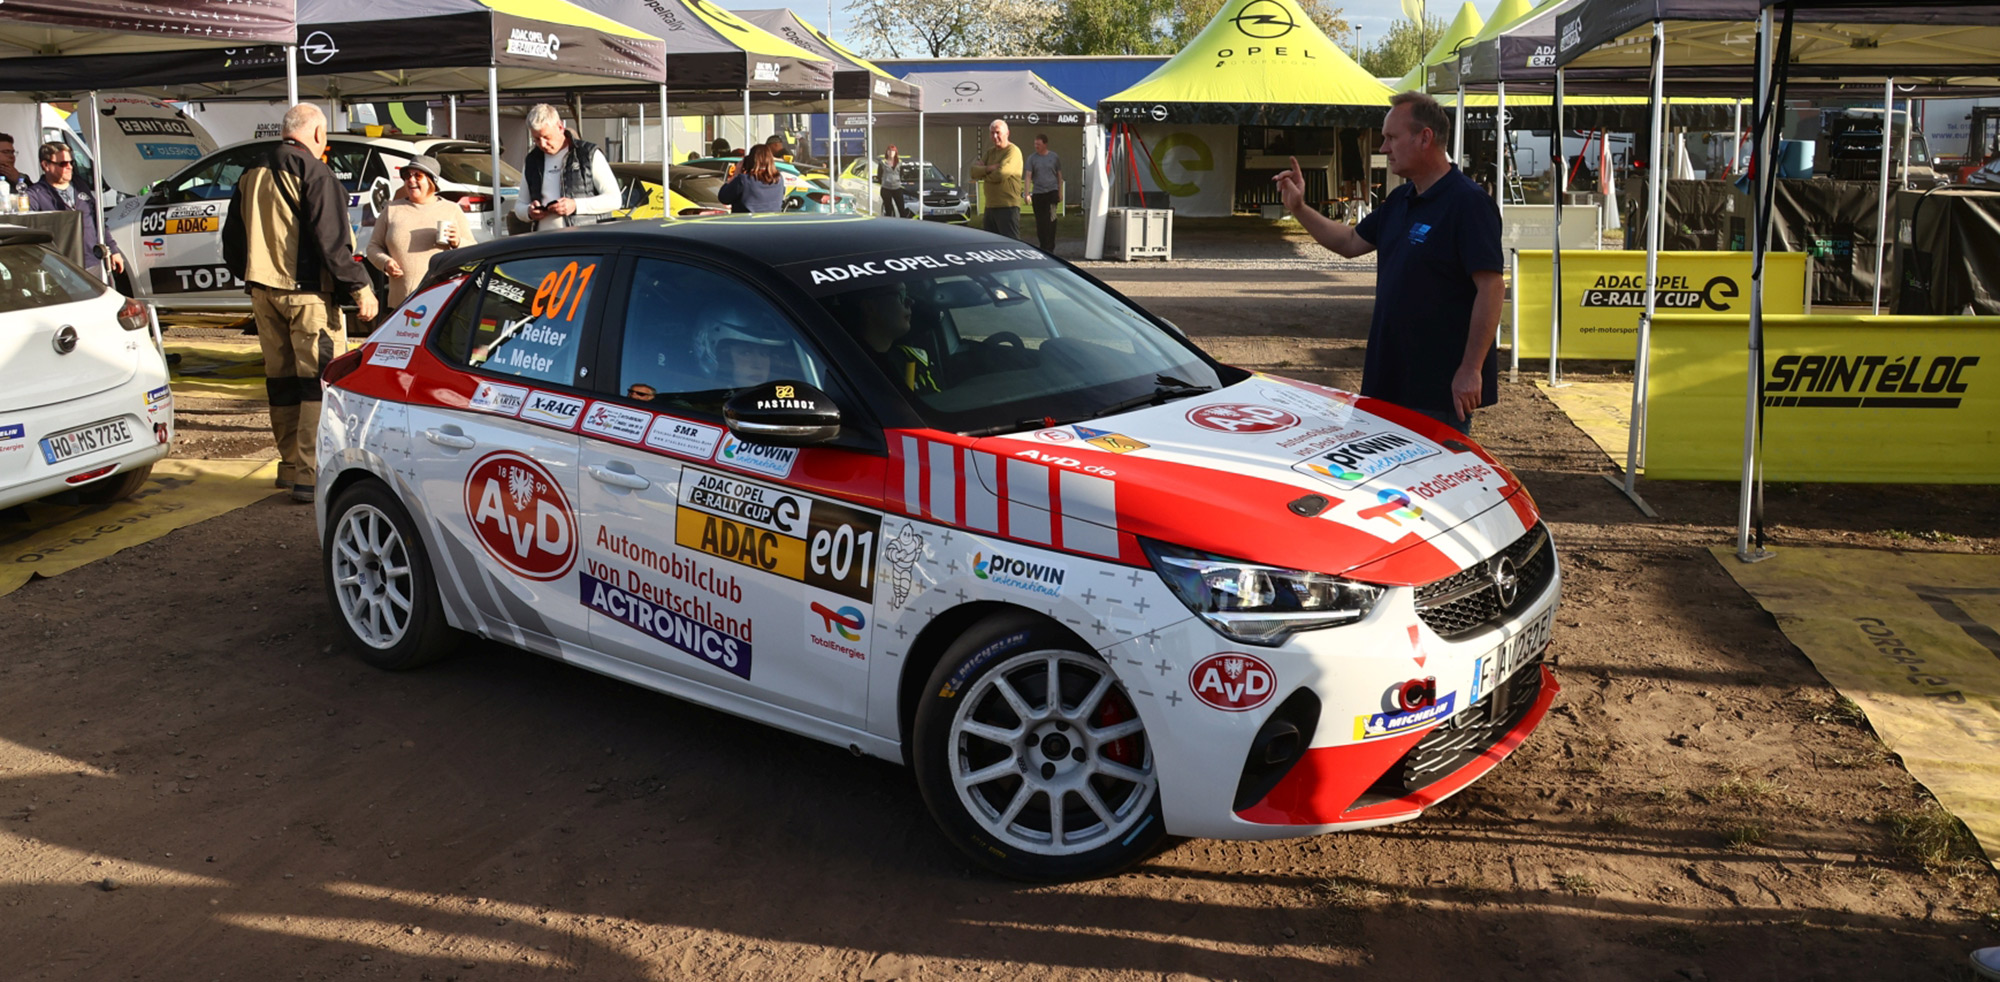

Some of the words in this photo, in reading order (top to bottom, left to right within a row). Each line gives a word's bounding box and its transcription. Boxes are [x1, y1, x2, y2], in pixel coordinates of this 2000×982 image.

[1217, 46, 1316, 59] OPEL
[1535, 46, 1556, 55] ADA
[119, 121, 191, 133] TOPLINER
[1057, 114, 1078, 123] ADAC
[142, 211, 166, 232] e05
[177, 217, 208, 233] ADAC
[1815, 239, 1850, 249] charge
[175, 267, 246, 290] TOPL
[809, 262, 887, 285] ADAC
[884, 255, 948, 272] OPEL
[943, 249, 1016, 266] e-RALLY
[1013, 249, 1048, 261] CUP
[531, 261, 597, 322] e01
[1594, 275, 1643, 289] ADAC
[1664, 292, 1700, 306] CUP
[501, 319, 517, 339] M.
[520, 323, 567, 347] Reiter
[494, 345, 506, 365] L.
[510, 348, 554, 373] Meter
[530, 397, 581, 418] X-RACE
[757, 399, 815, 411] PASTABOX
[1207, 404, 1286, 433] AvD
[51, 438, 72, 459] HO
[77, 431, 96, 452] MS
[95, 422, 131, 447] 773E
[673, 424, 699, 438] SMR
[0, 443, 25, 452] Energies
[735, 454, 788, 473] international
[1015, 449, 1117, 477] AvD.de
[498, 465, 507, 479] 18
[535, 481, 548, 495] 99
[698, 475, 733, 494] ADAC
[733, 484, 765, 503] OPEL
[1405, 463, 1492, 501] TotalEnergies
[475, 477, 570, 559] AvD
[692, 489, 744, 516] e-RALLY
[743, 503, 771, 522] CUP
[596, 524, 743, 604] Automobilclub
[701, 516, 779, 570] ADAC
[811, 523, 874, 589] e01
[991, 572, 1062, 598] international
[588, 558, 621, 587] von
[627, 570, 752, 643] Deutschland
[591, 582, 739, 669] ACTRONICS
[810, 634, 866, 661] TotalEnergies
[959, 633, 1024, 679] MICHELIN
[1198, 667, 1271, 703] AvD
[1480, 656, 1492, 693] F
[1387, 701, 1449, 729] MICHELIN
